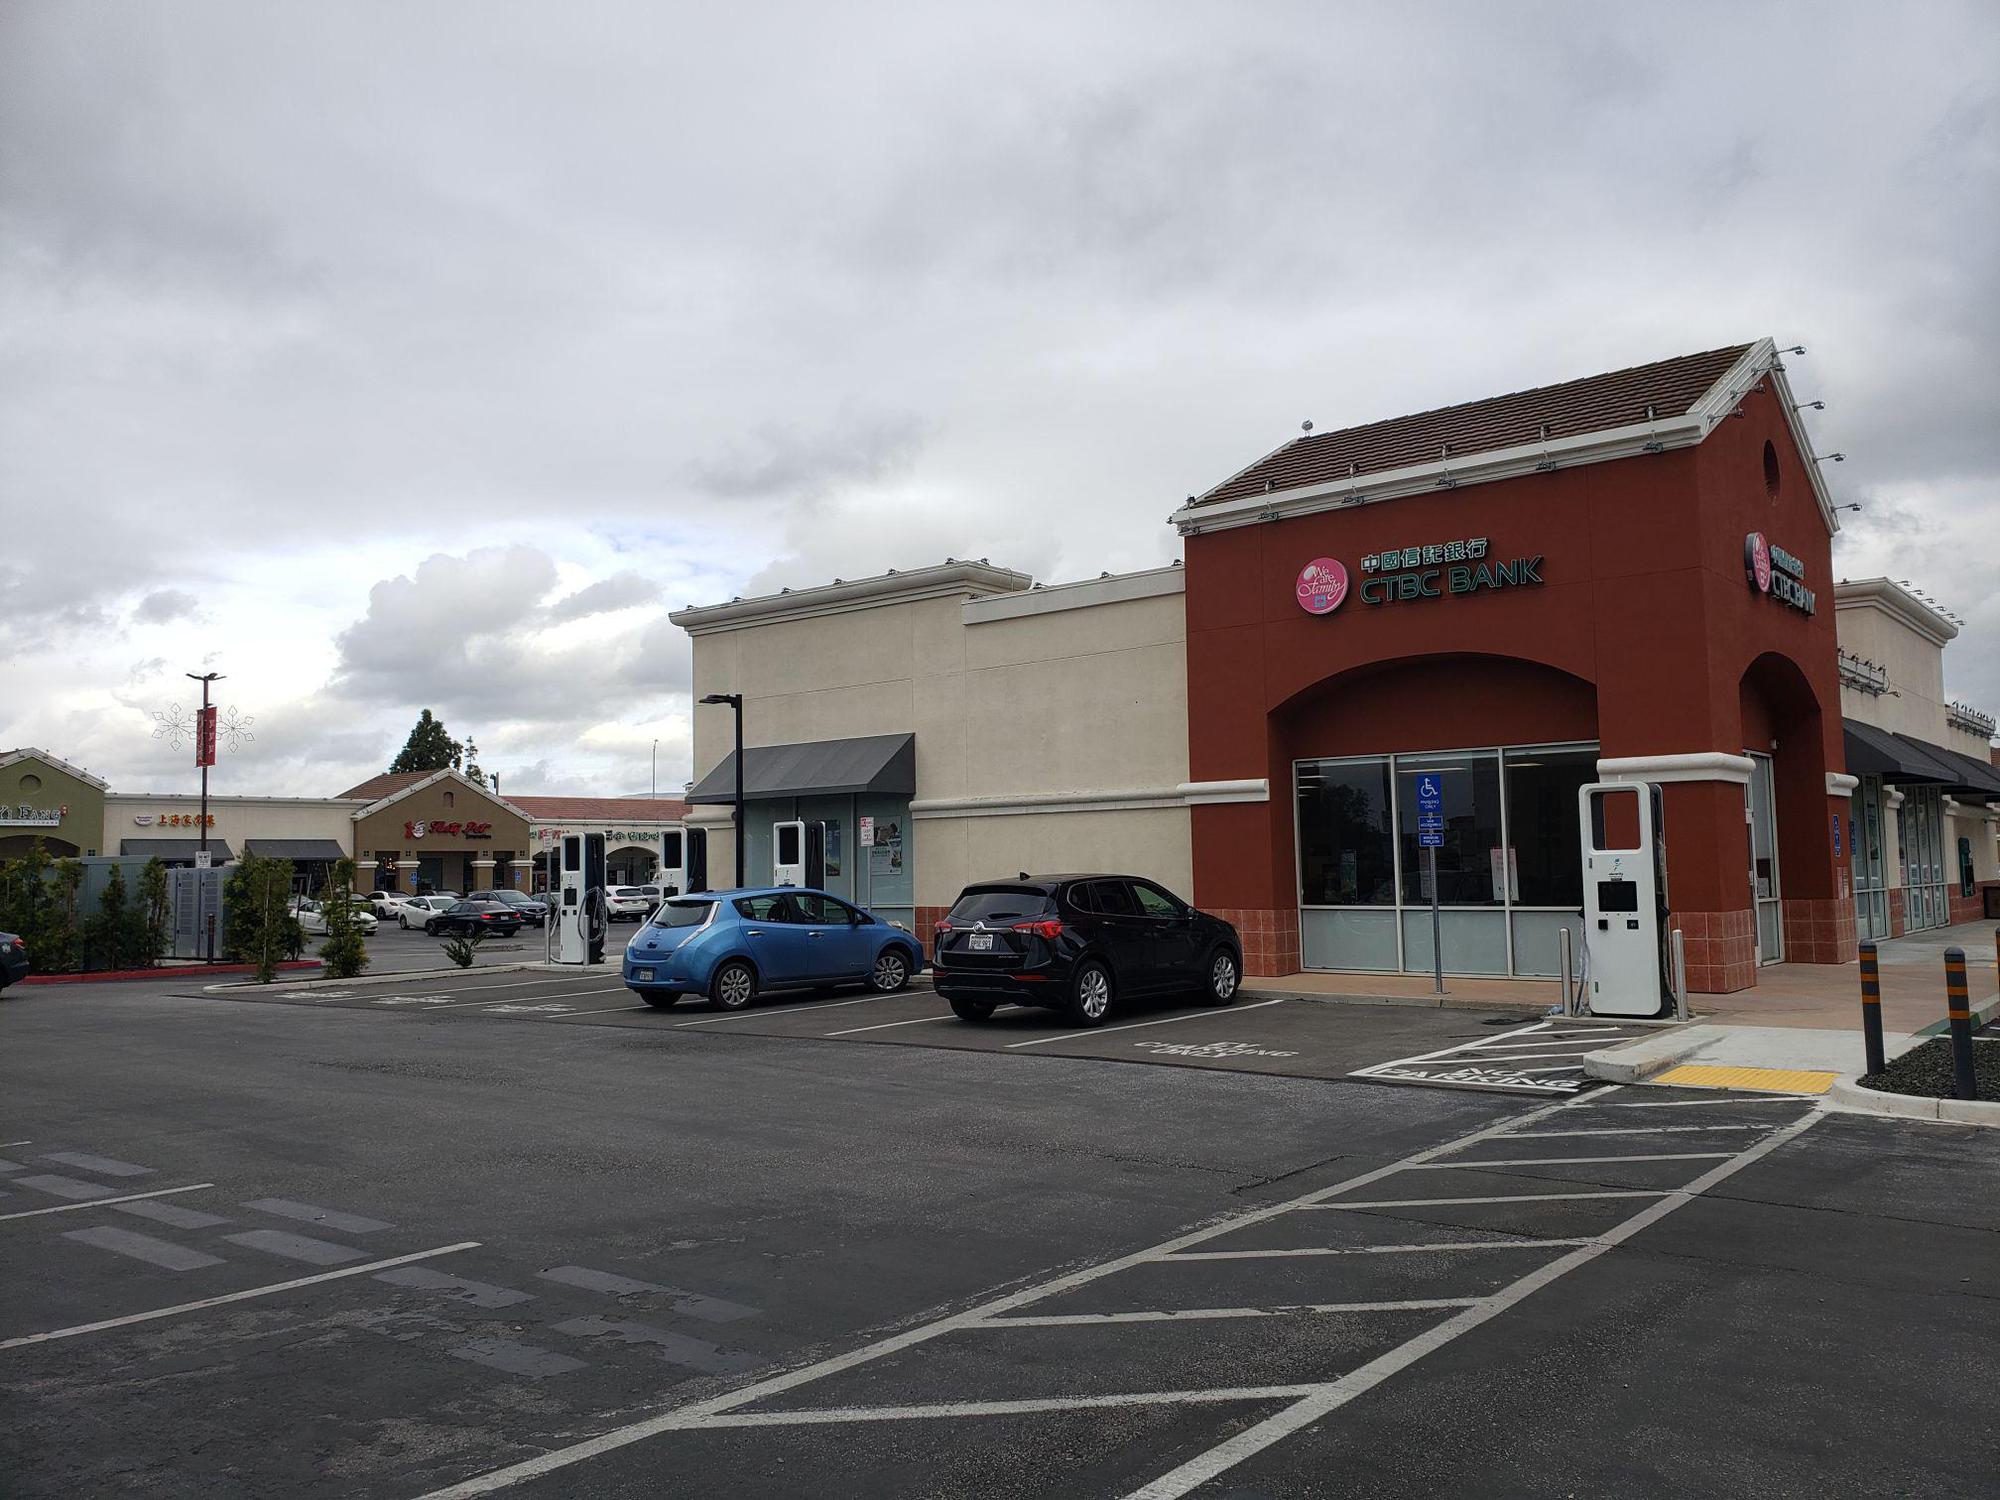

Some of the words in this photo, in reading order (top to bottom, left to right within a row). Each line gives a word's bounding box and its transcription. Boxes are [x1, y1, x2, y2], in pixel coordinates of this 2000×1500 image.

[1361, 537, 1488, 573] 中國信託銀行
[1298, 576, 1344, 599] family
[1360, 570, 1440, 604] CTBC
[1448, 556, 1544, 593] BANK
[1371, 1068, 1582, 1088] PARKING
[1455, 1067, 1526, 1077] NO
